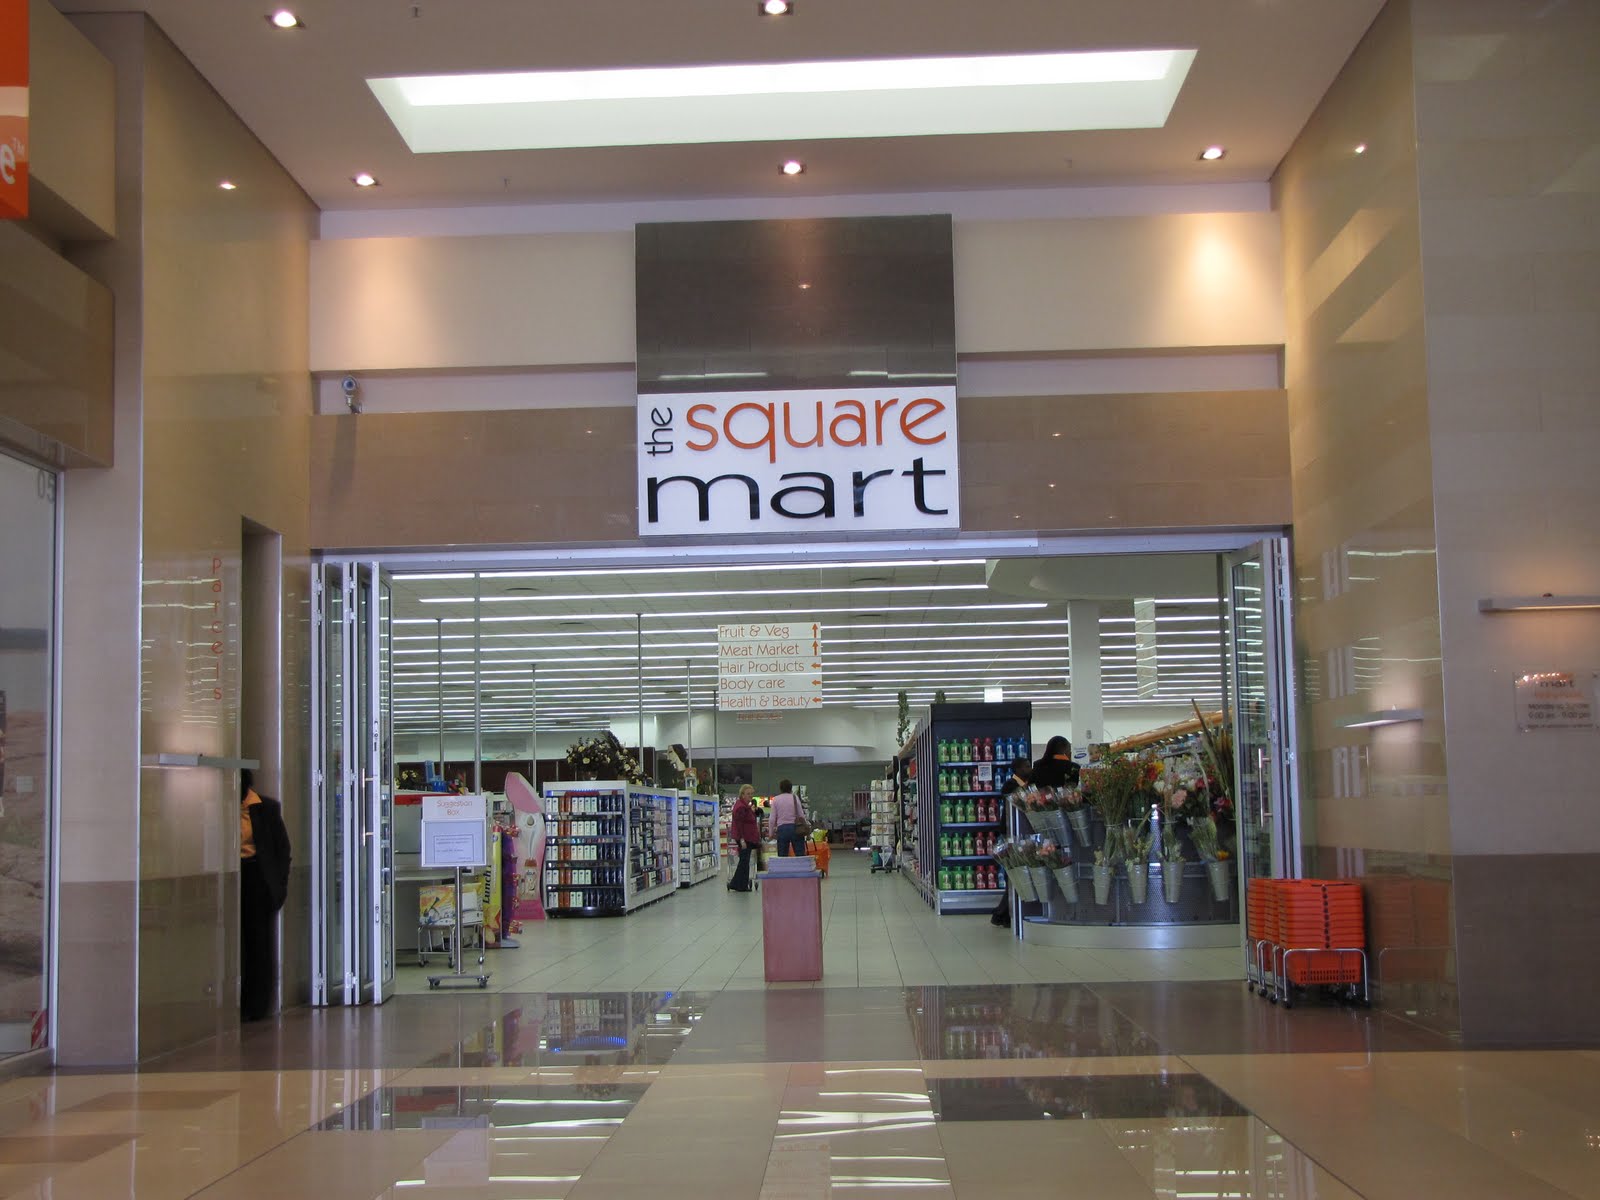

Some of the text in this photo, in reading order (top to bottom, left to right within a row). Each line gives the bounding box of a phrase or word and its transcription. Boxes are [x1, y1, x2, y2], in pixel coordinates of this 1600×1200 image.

[644, 397, 947, 464] the square
[647, 456, 949, 523] mart
[719, 624, 790, 639] Fruit & Veg
[720, 643, 800, 657] Meat Market
[720, 660, 805, 674] Hair Products
[720, 677, 786, 691] Body care
[720, 694, 811, 708] Health & Beauty
[436, 800, 473, 808] Suggestion
[482, 870, 492, 905] Lunch
